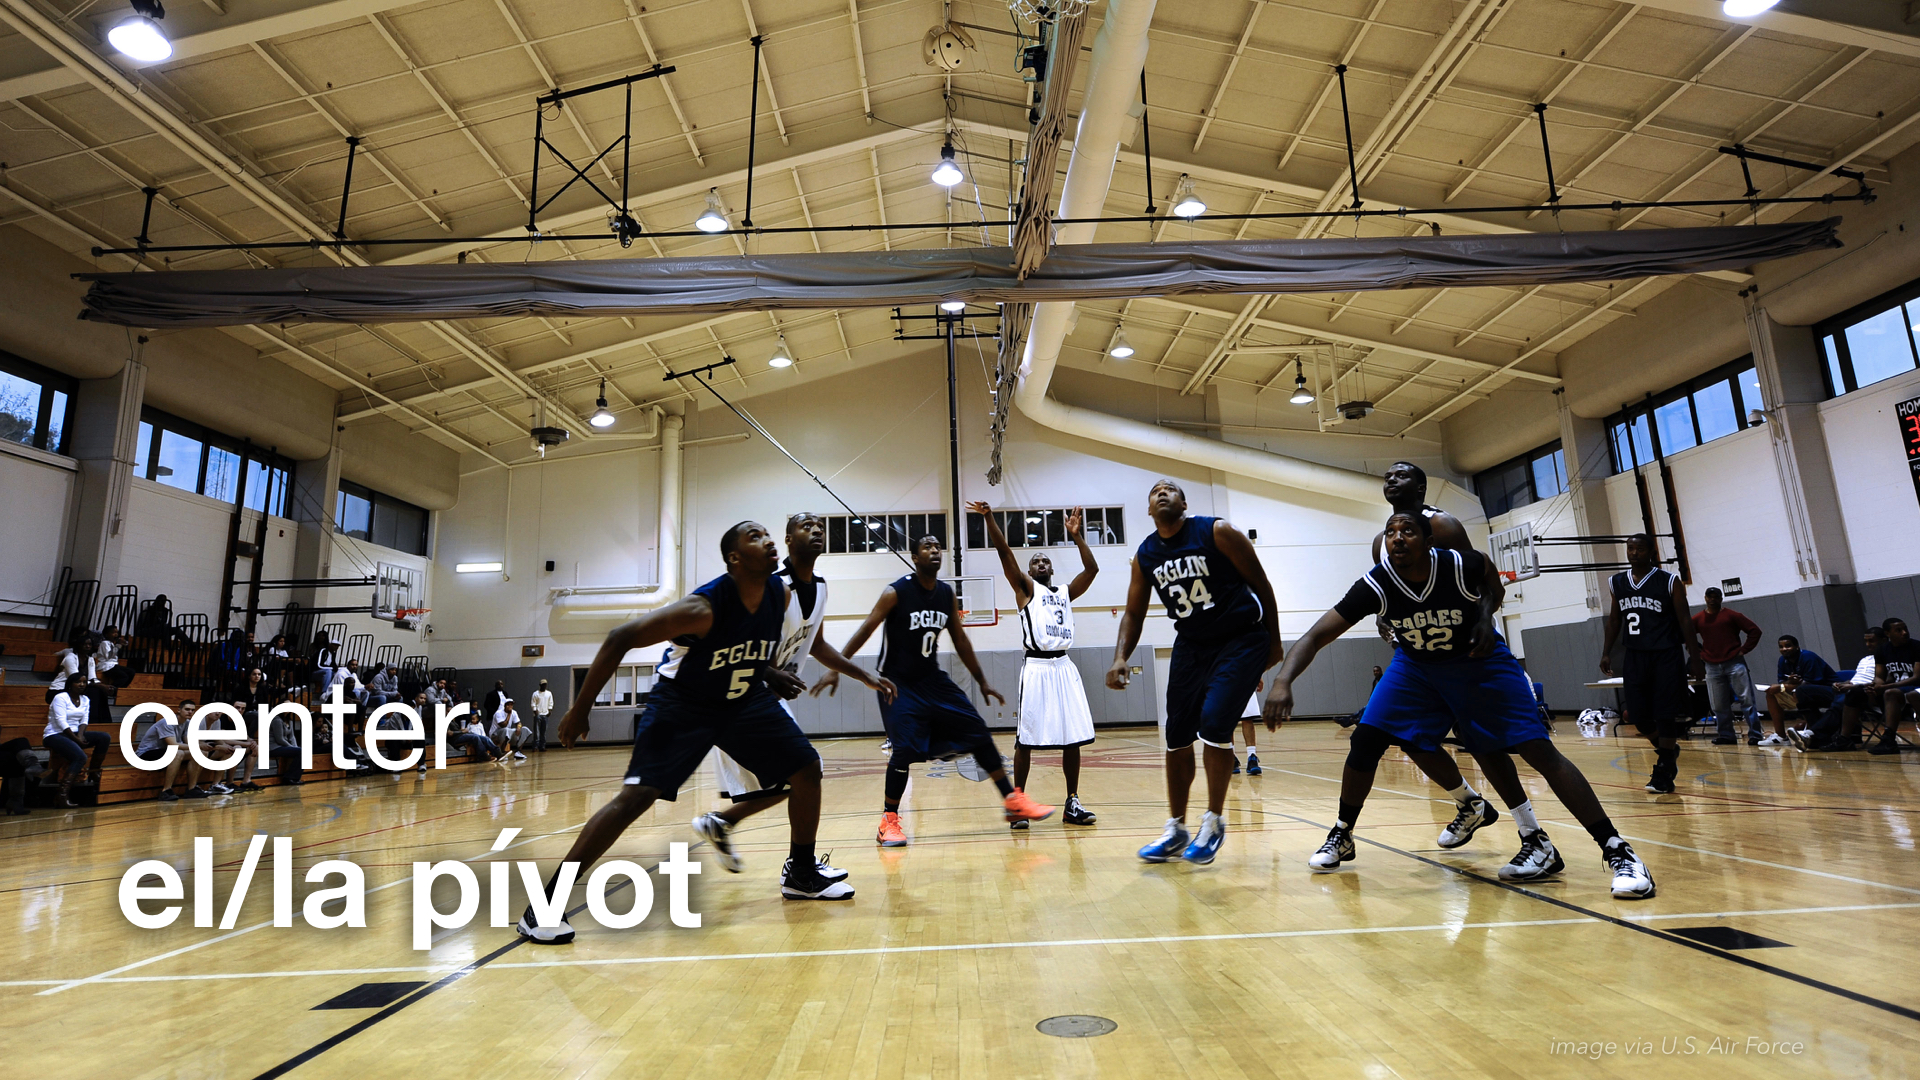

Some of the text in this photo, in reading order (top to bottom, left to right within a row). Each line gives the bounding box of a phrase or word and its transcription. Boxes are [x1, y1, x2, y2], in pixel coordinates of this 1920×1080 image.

[1153, 555, 1210, 589] EGLIN
[1169, 579, 1215, 618] 34
[1619, 597, 1662, 613] EAGLES
[1054, 610, 1064, 625] 3
[1390, 609, 1463, 629] EAGLES
[1627, 613, 1640, 635] 2
[921, 631, 937, 658] 0
[1401, 627, 1453, 651] 42
[726, 668, 755, 699] 5
